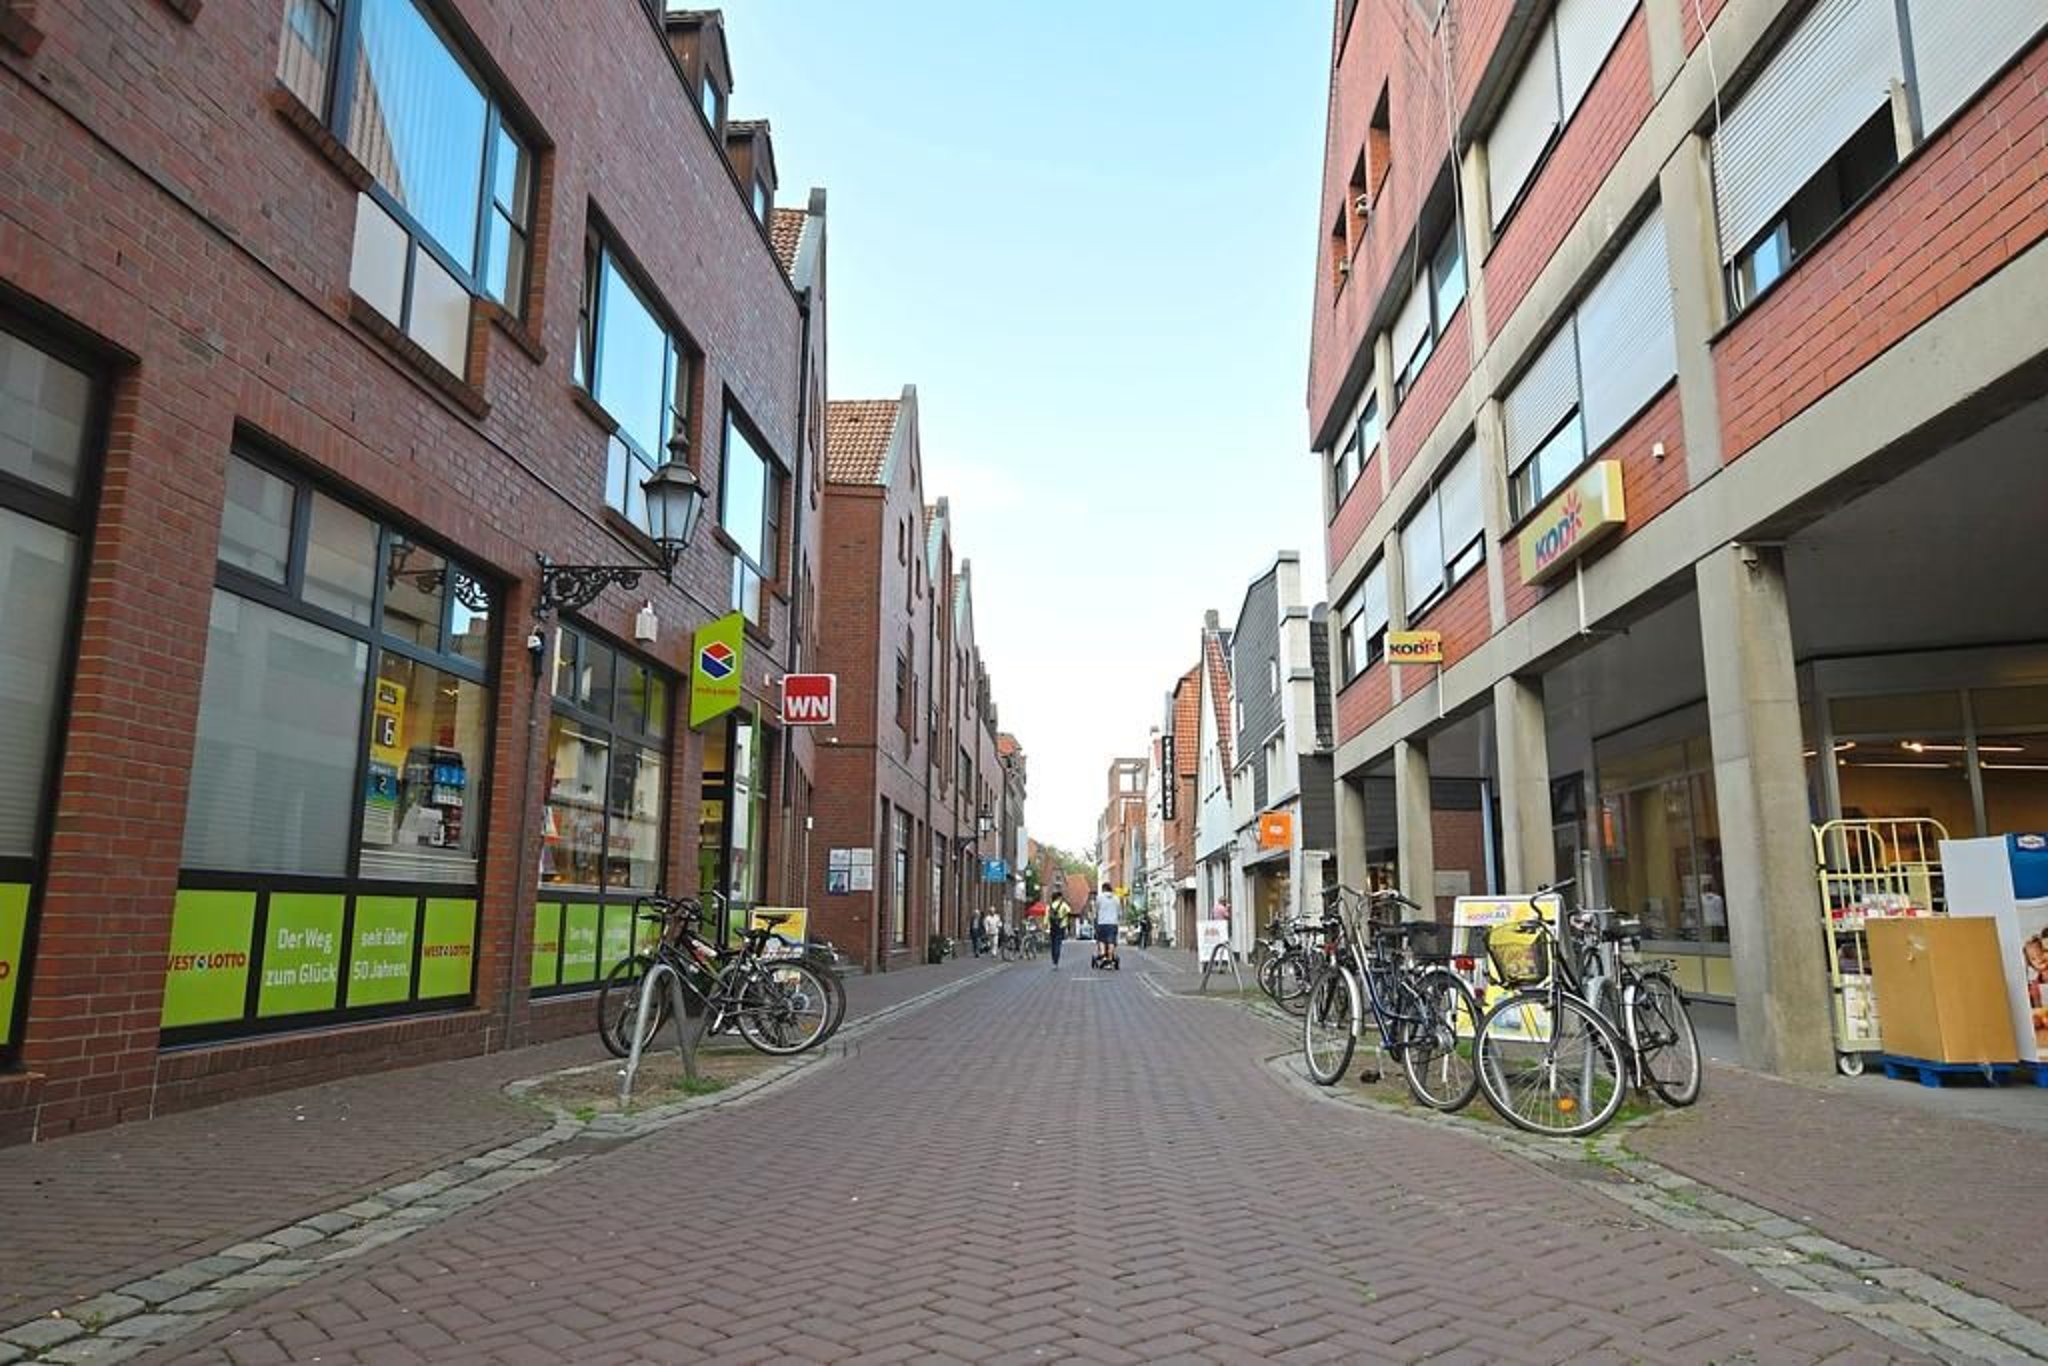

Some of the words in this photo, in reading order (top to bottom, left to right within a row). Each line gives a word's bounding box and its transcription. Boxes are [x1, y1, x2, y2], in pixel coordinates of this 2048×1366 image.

[787, 696, 829, 717] WN
[277, 928, 304, 949] Der
[305, 928, 333, 953] Weg
[361, 929, 382, 947] seit
[384, 928, 408, 945] über
[207, 952, 246, 969] LOTTO
[353, 961, 369, 980] 50
[266, 968, 297, 986] zum
[300, 963, 337, 984] Glück
